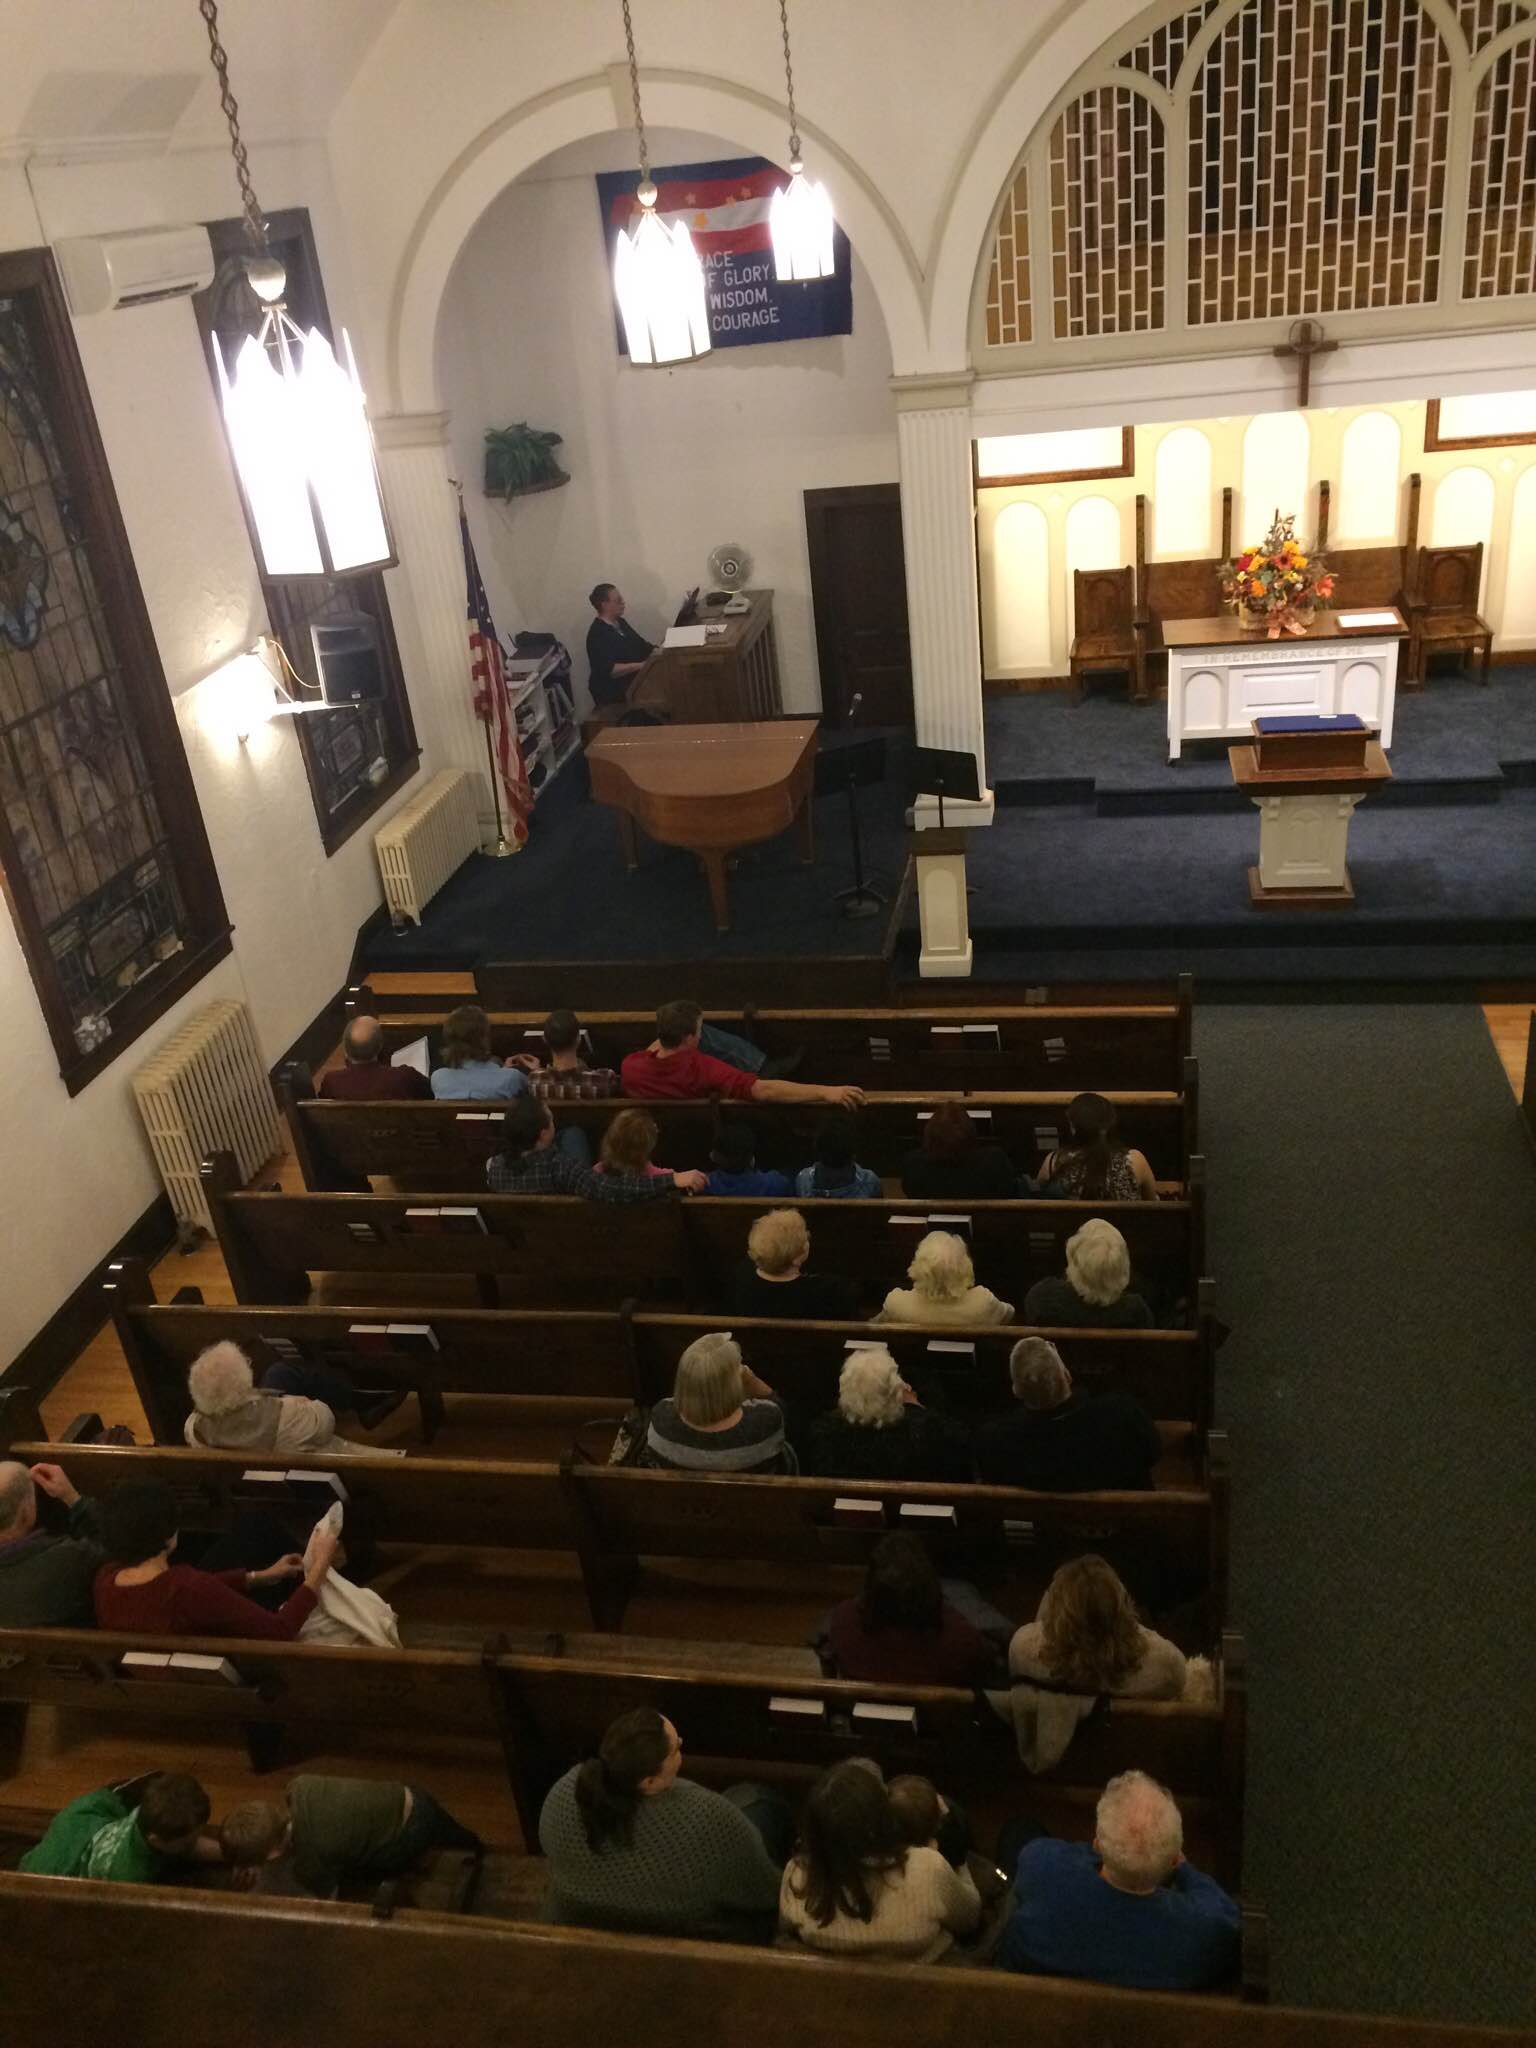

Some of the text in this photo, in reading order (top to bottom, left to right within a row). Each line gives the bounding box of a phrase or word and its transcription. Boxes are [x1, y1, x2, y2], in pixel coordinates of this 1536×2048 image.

[697, 250, 733, 268] RACE
[712, 306, 780, 332] COURAGE
[1204, 654, 1217, 665] IN
[1327, 648, 1344, 658] OF
[1347, 647, 1365, 657] ME
